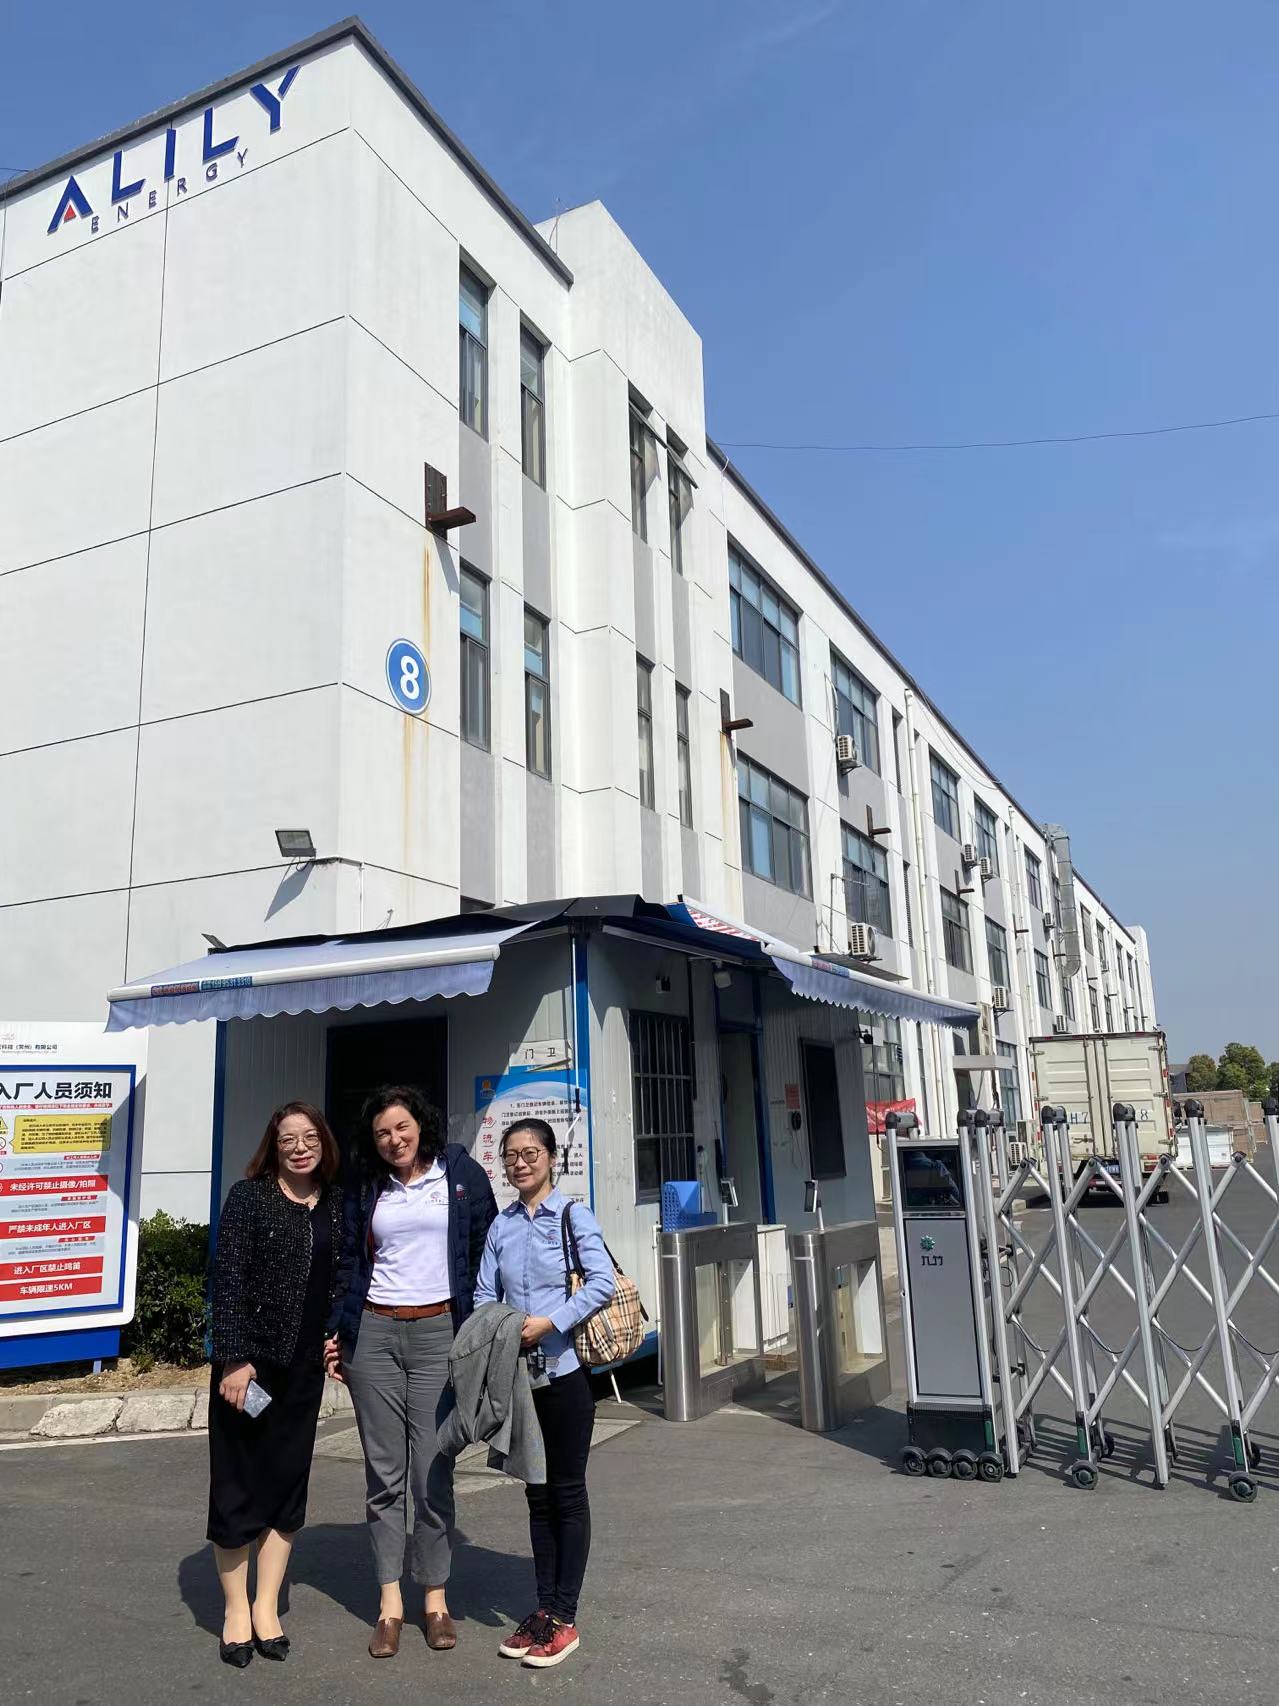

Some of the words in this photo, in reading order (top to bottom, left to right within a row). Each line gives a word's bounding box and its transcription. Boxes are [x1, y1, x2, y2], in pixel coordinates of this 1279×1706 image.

[48, 65, 300, 234] ALILY
[91, 148, 248, 233] ENERGY
[401, 655, 420, 700] 8
[9, 1179, 96, 1192] 未经许可禁止摄像/拍照
[8, 1220, 92, 1234] 严禁未成年人进入厂区
[14, 1261, 81, 1275] 进入厂区禁止鸣笛
